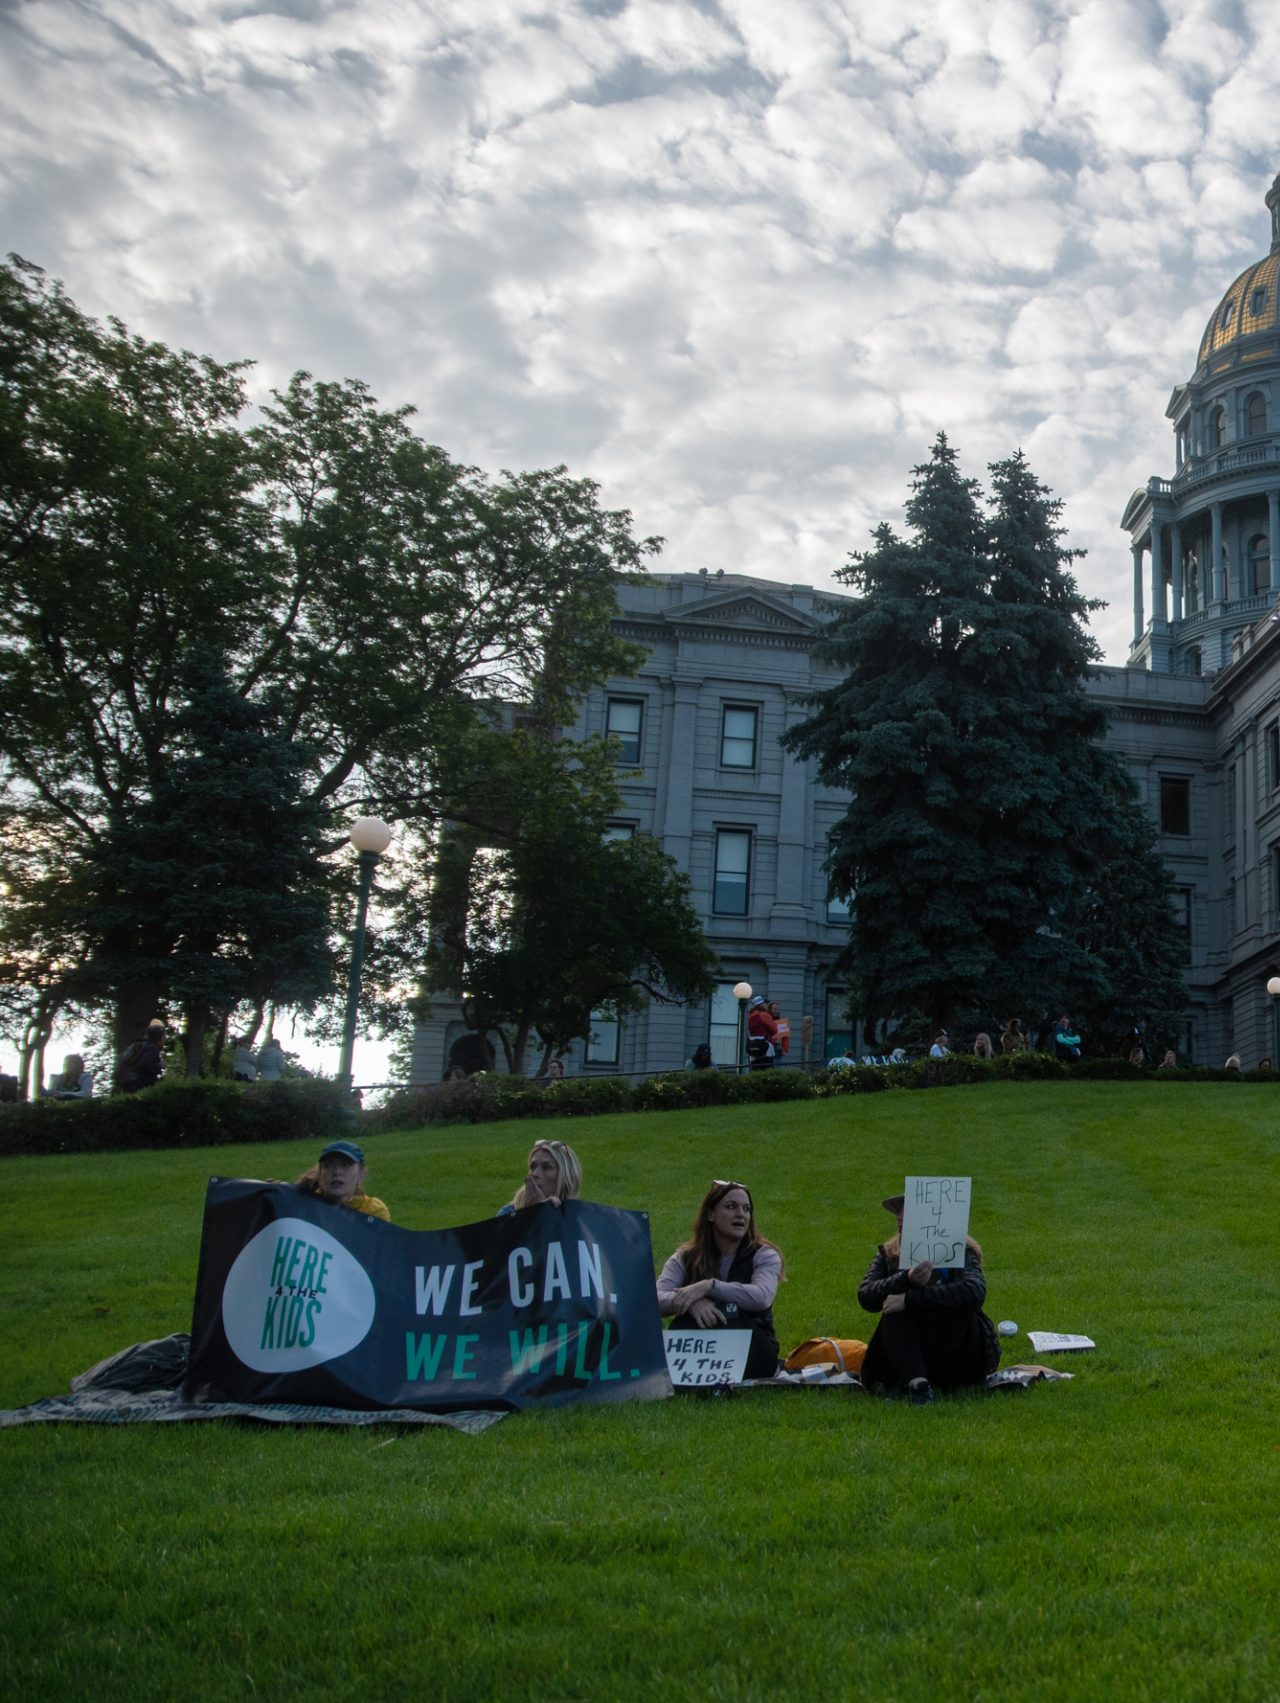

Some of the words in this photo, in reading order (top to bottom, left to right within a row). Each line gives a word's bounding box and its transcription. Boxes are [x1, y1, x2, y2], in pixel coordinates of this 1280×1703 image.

[915, 1178, 966, 1205] HERE
[931, 1204, 943, 1225] 4
[270, 1236, 333, 1294] HERE
[909, 1241, 964, 1267] KIDS
[415, 1259, 485, 1316] WE
[507, 1240, 617, 1308] CAN.
[275, 1286, 283, 1297] 4
[288, 1286, 318, 1301] THE
[260, 1295, 322, 1350] KIDS
[405, 1331, 480, 1381] WE
[508, 1320, 641, 1381] WILL.
[666, 1337, 718, 1354] HERE
[672, 1358, 687, 1371] 4
[697, 1358, 736, 1370] THE
[680, 1372, 731, 1385] KIDS
